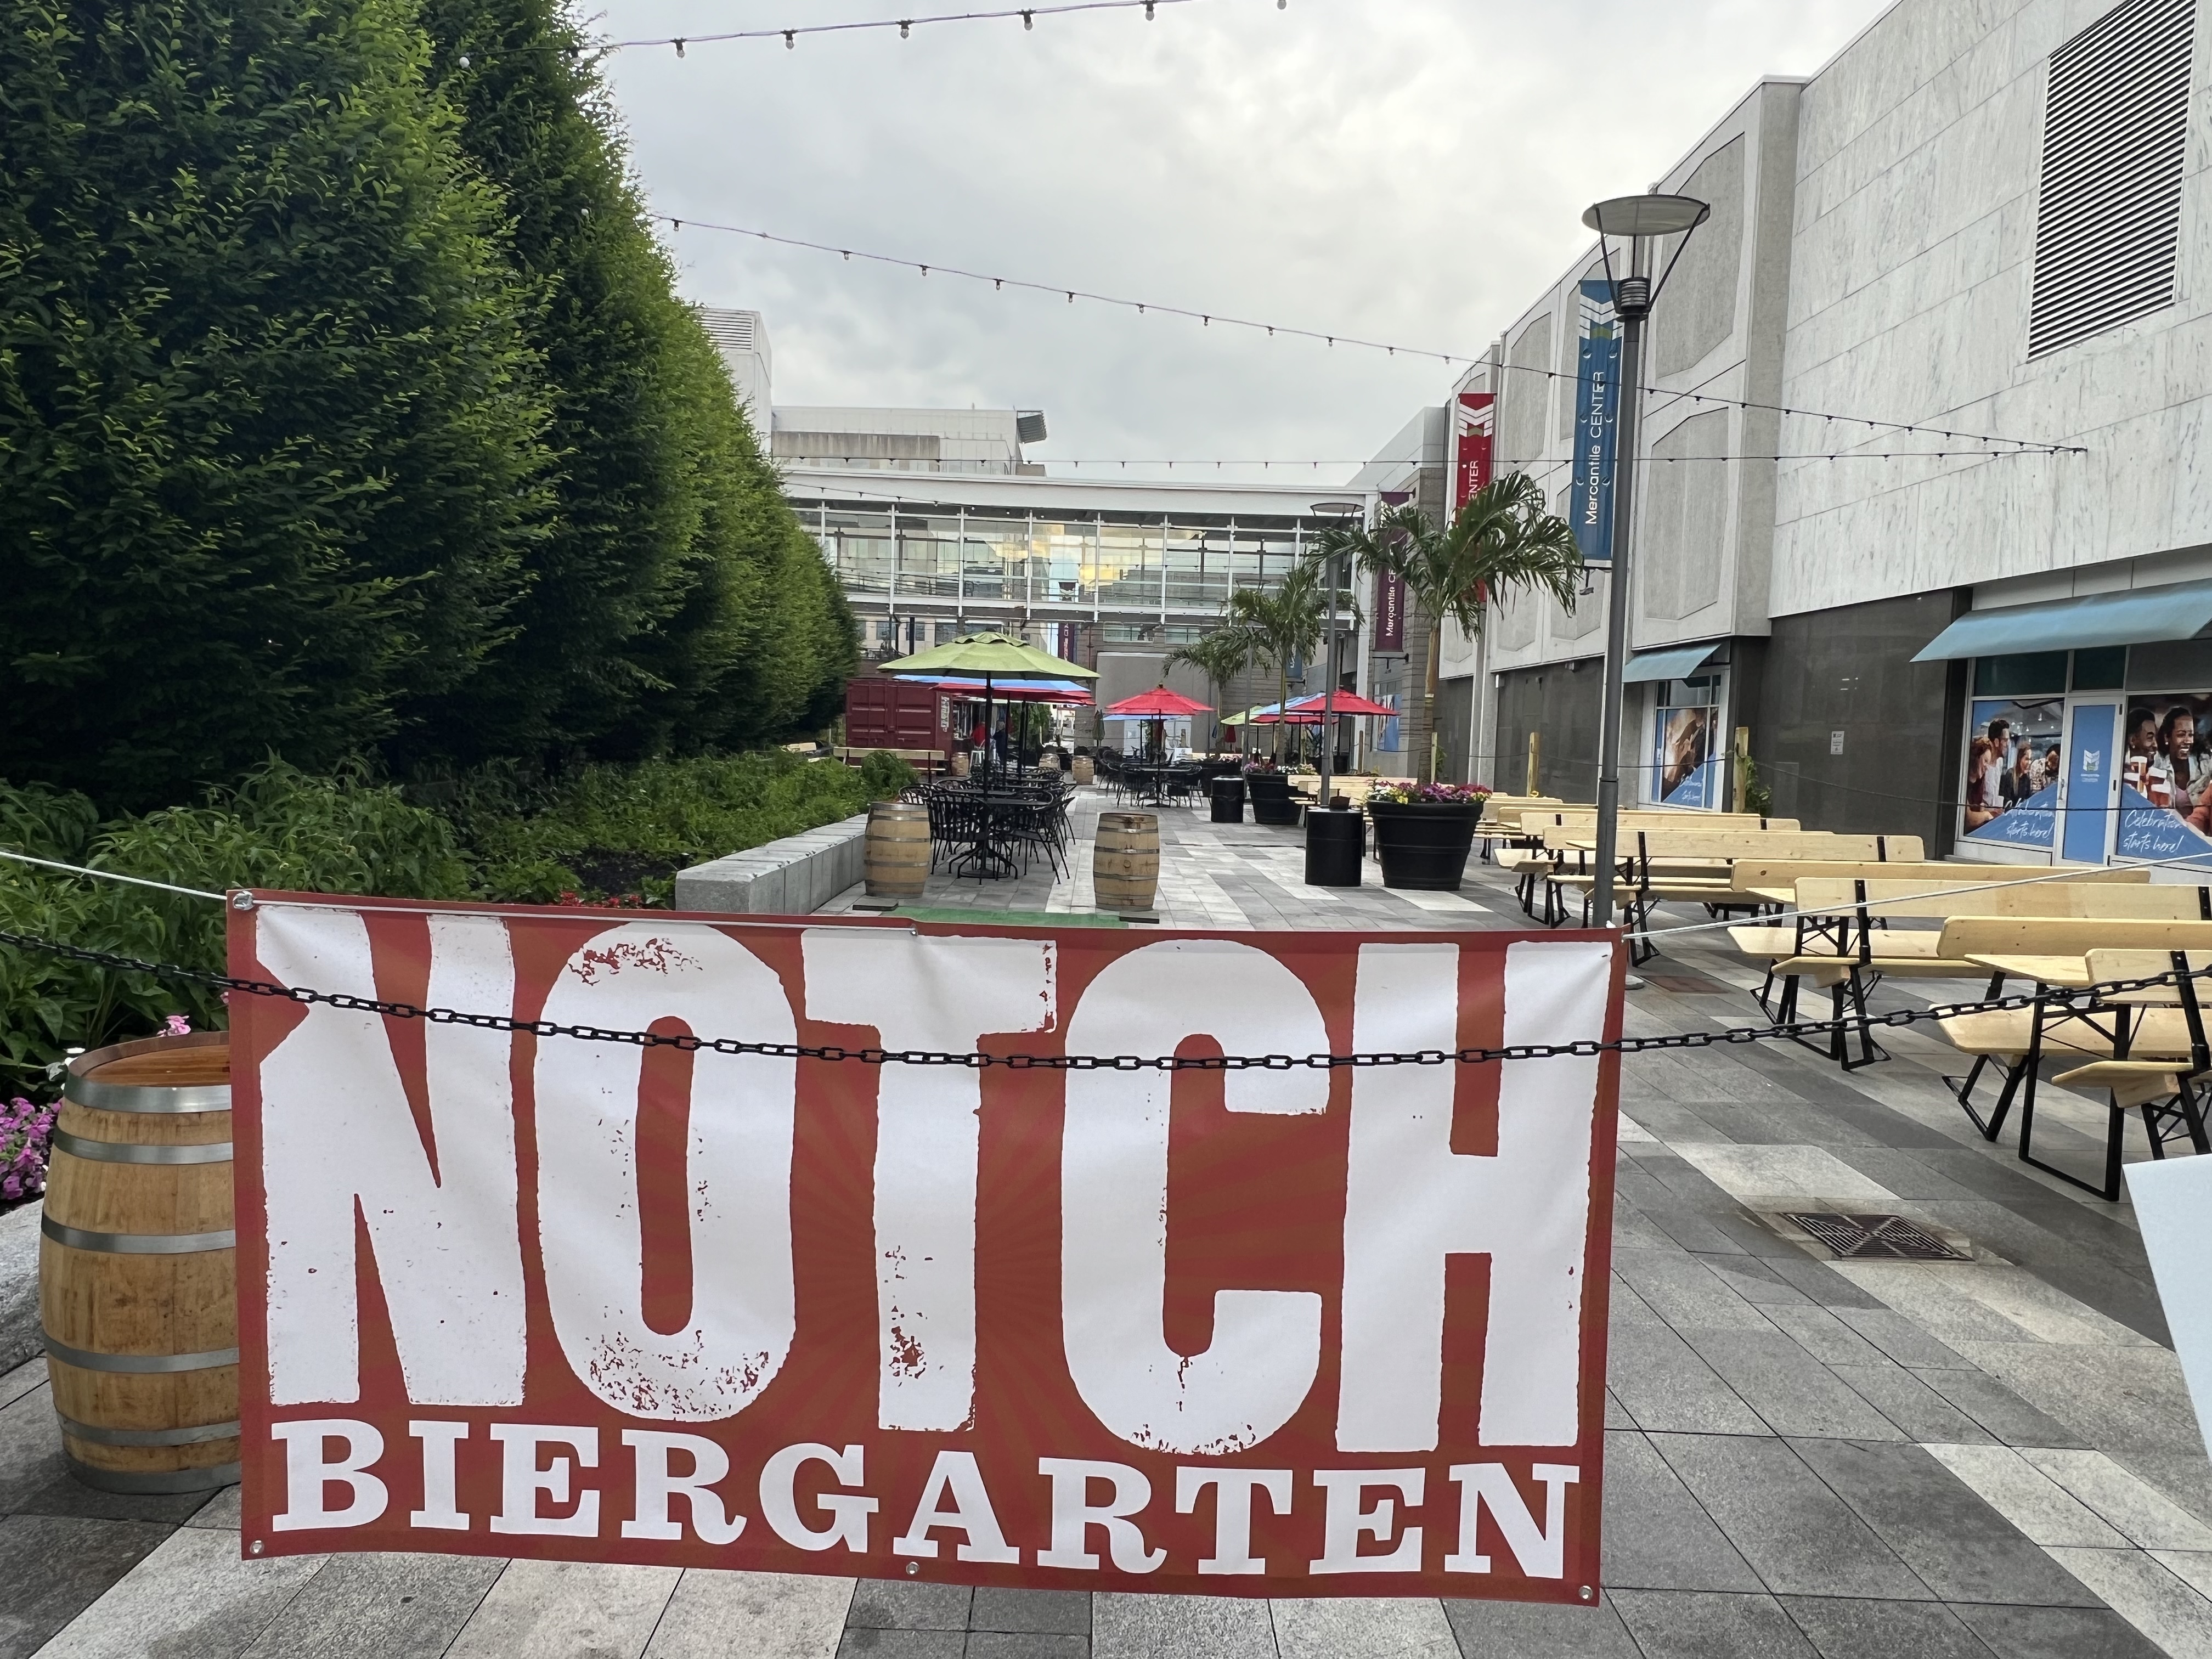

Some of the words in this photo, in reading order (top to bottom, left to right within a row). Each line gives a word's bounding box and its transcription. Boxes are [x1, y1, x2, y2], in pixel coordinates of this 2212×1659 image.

[1590, 371, 1605, 438] CENTER
[1469, 460, 1479, 501] ENTER
[1585, 445, 1601, 524] Mercantile
[2123, 831, 2151, 853] starts
[256, 905, 1613, 1455] NOTCH
[272, 1419, 1581, 1581] BIERGARTEN
